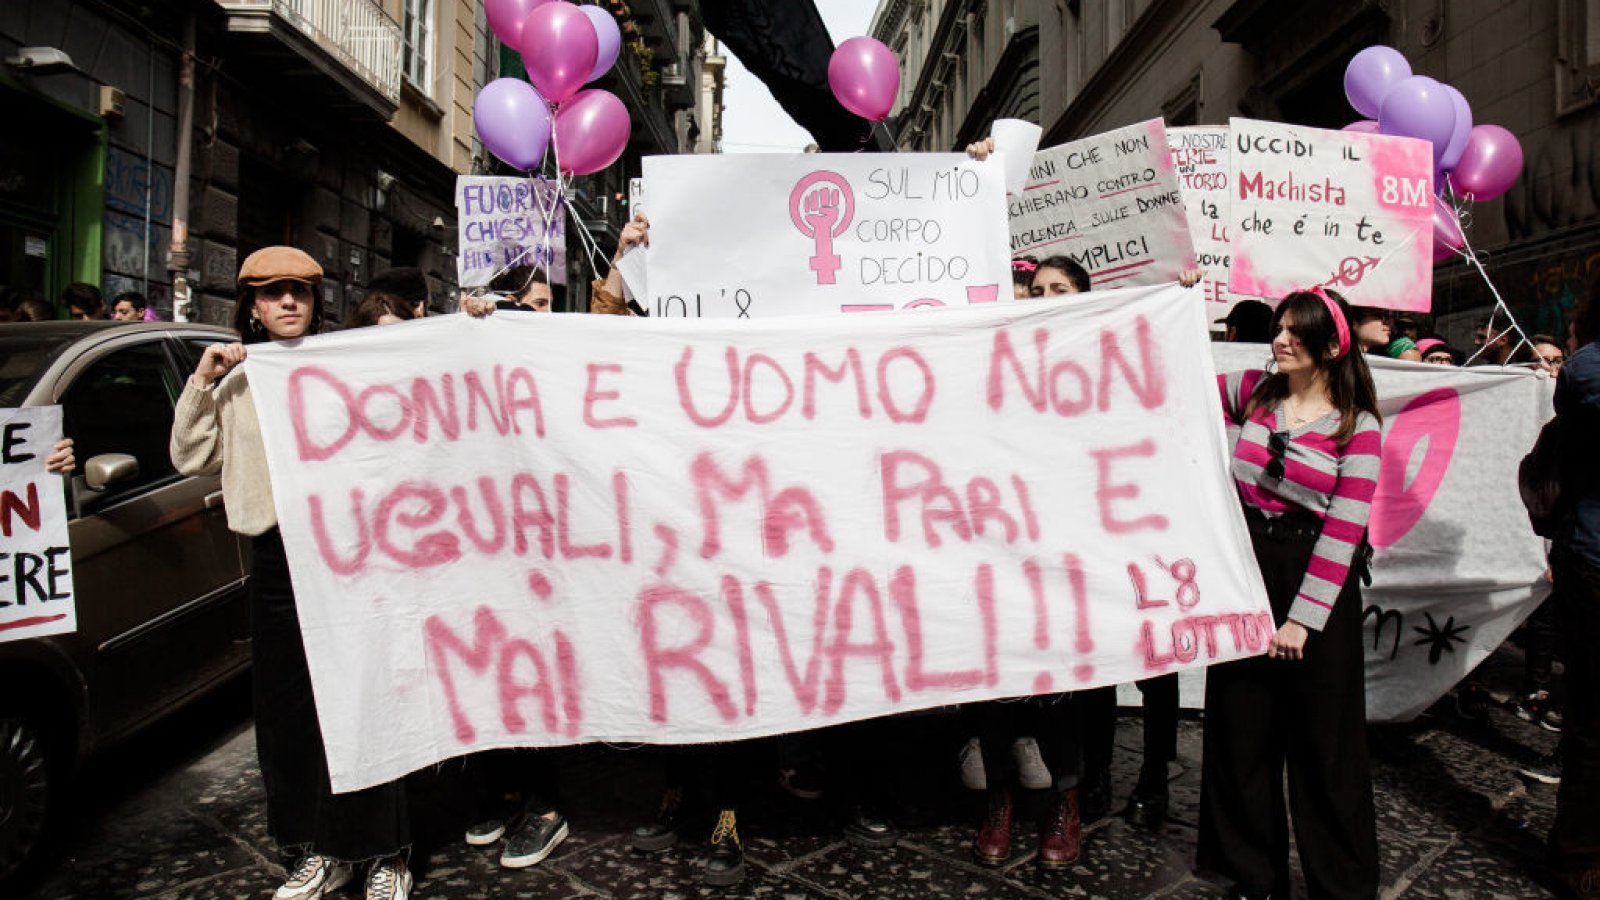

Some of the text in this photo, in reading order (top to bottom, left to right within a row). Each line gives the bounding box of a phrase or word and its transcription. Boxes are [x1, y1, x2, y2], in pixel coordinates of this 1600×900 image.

[1067, 146, 1101, 170] CHE
[1115, 135, 1149, 157] NON
[1343, 145, 1361, 161] IL
[865, 166, 979, 201] SUL MIO
[1097, 168, 1156, 193] CONTRO
[1239, 170, 1346, 205] Machista
[1381, 175, 1428, 208] 8M
[464, 184, 535, 216] FUORI
[1092, 206, 1128, 227] SULLE
[1136, 191, 1180, 213] DONNE
[465, 218, 535, 241] CHIESA
[856, 218, 941, 245] CORPO
[1241, 210, 1273, 234] che
[1324, 215, 1340, 237] in
[1356, 216, 1384, 244] te
[860, 252, 970, 286] DECIDO
[289, 315, 1167, 461] DONNA E UOMO NON
[690, 451, 836, 560] MA
[879, 449, 1041, 549] PARI
[1088, 438, 1170, 534] E
[1126, 554, 1200, 612] L'8
[424, 552, 1095, 744] MAI RIVALI!!
